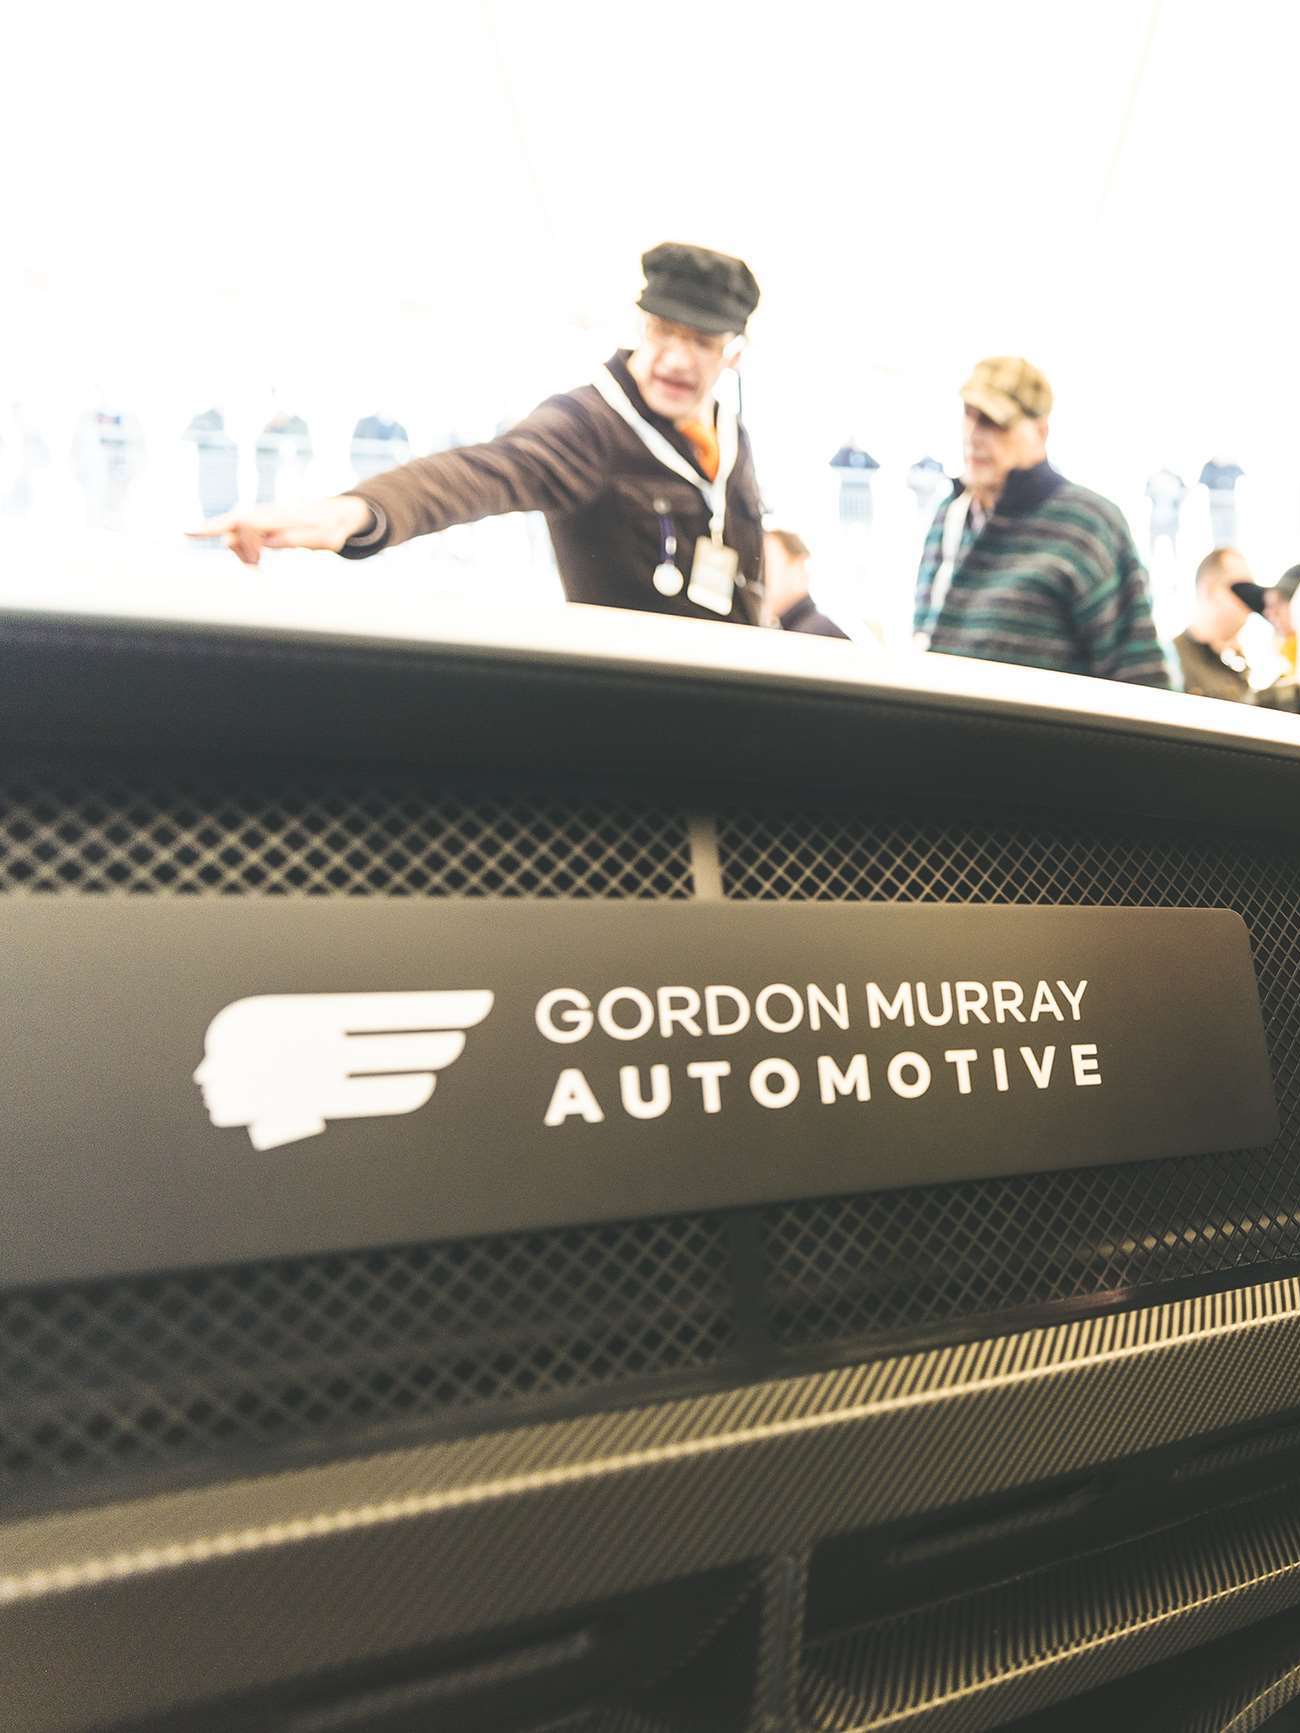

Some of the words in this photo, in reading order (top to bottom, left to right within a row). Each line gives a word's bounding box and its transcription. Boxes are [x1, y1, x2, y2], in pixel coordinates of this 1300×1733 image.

[534, 982, 850, 1044] GORDON
[865, 979, 1088, 1029] MURRAY
[543, 1043, 1103, 1127] AUTOMOTIVE
